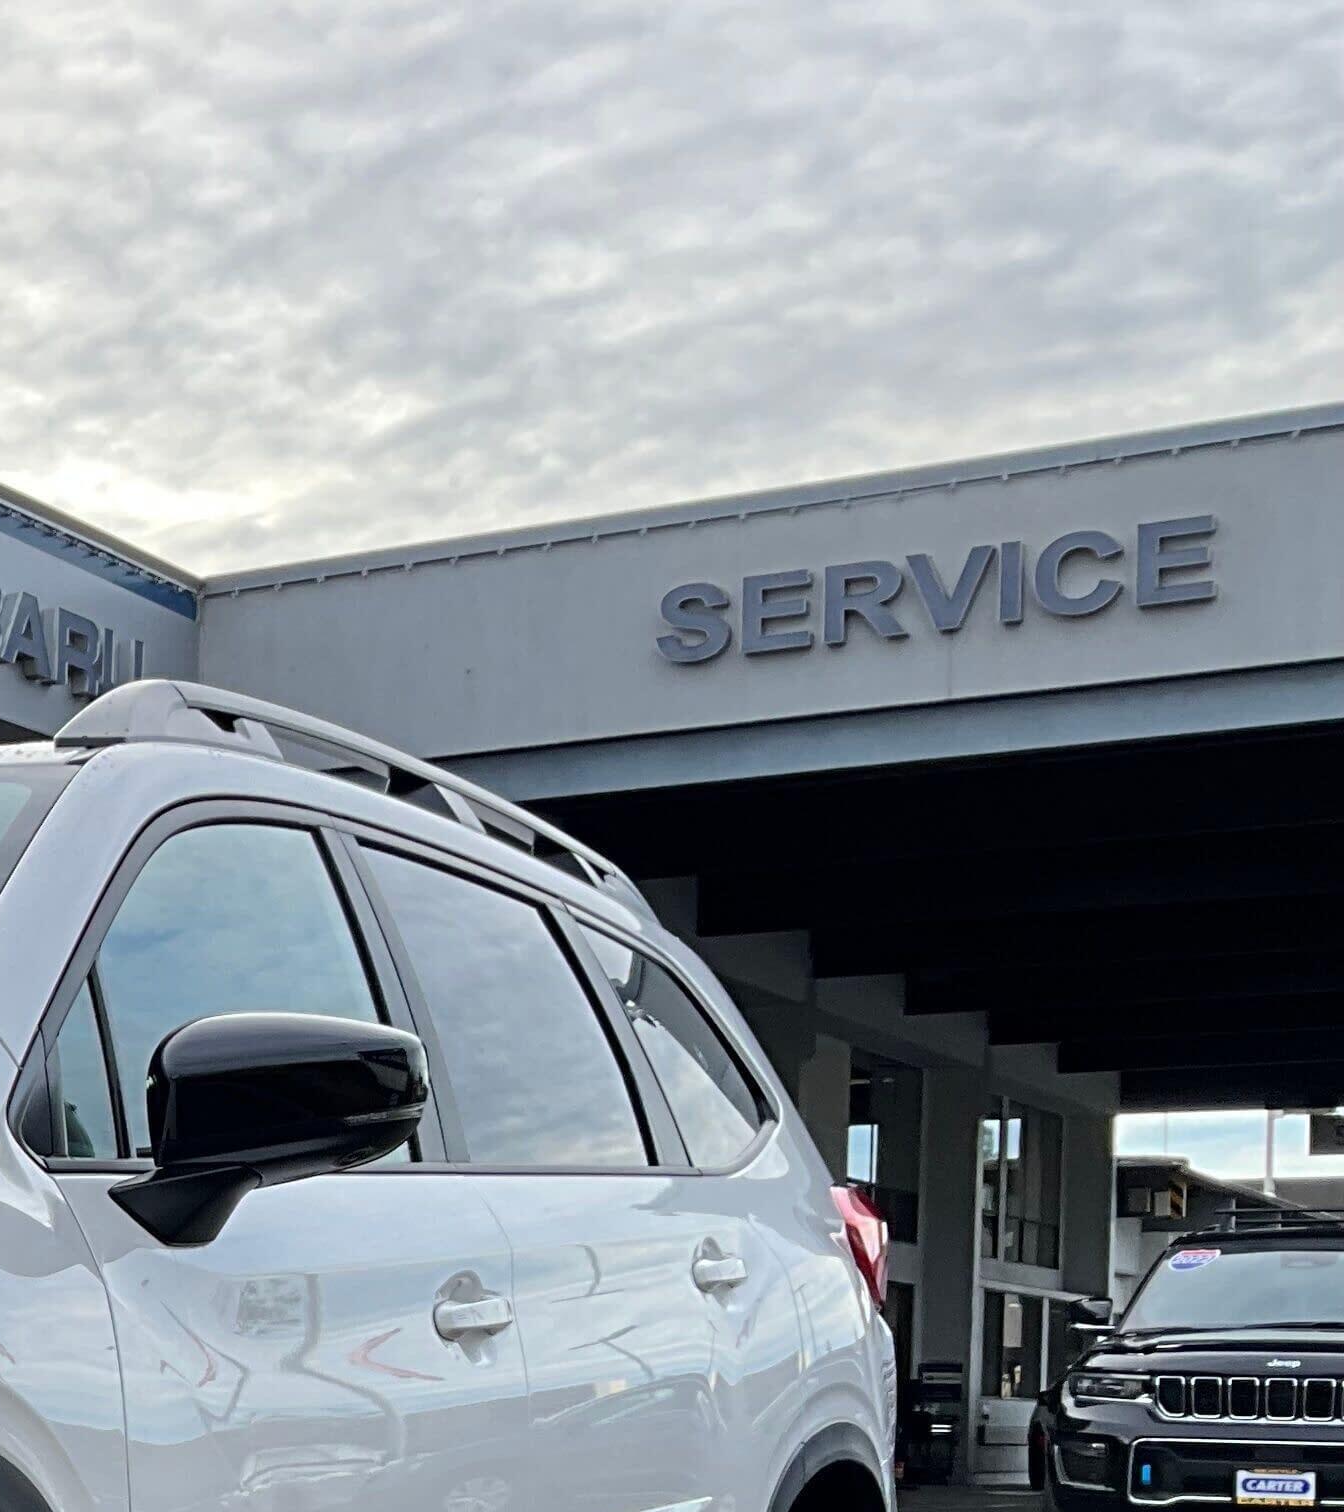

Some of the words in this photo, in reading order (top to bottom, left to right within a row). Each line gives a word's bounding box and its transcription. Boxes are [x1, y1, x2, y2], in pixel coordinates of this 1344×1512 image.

[656, 514, 1216, 664] SERVICE
[1266, 1358, 1302, 1369] Jeep
[1245, 1479, 1304, 1493] CARTER
